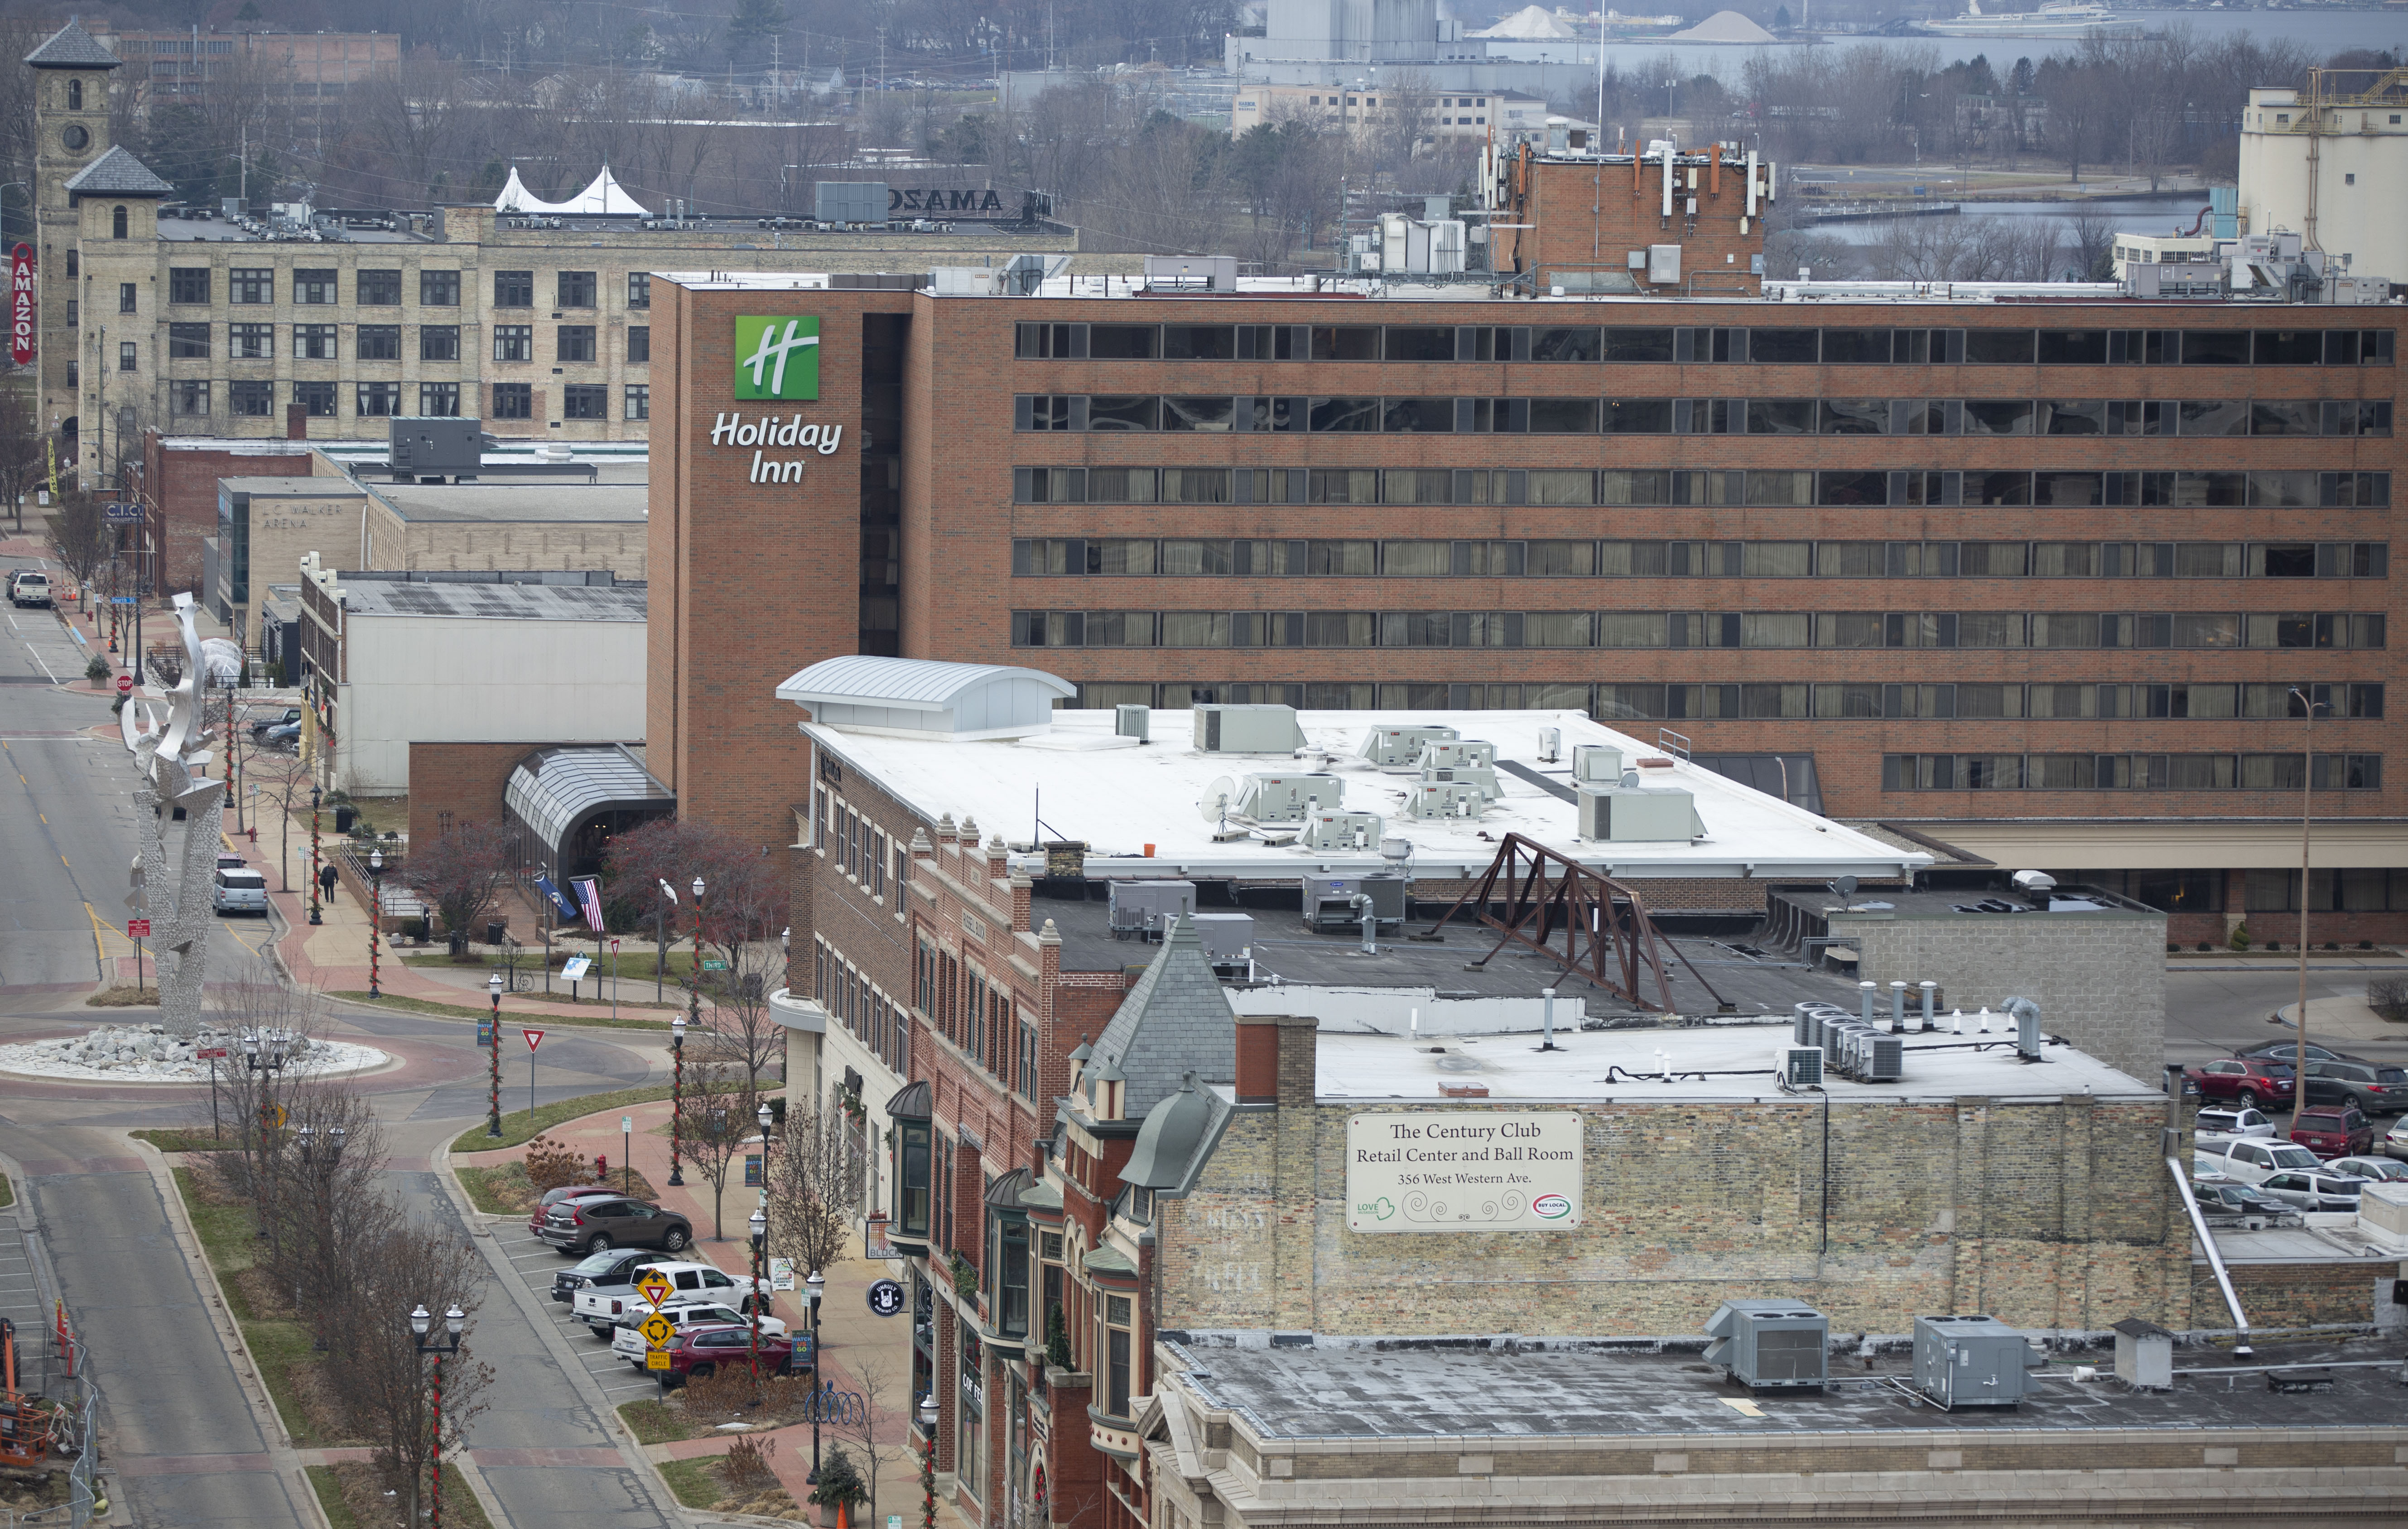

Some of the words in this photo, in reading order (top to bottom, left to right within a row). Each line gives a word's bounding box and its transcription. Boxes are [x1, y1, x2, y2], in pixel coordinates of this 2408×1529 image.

[15, 262, 31, 351] AMAZON
[710, 413, 842, 454] Holiday
[750, 450, 802, 483] Inn
[291, 504, 342, 515] WALKER
[264, 518, 308, 528] ARENA
[963, 912, 975, 934] RUSSELL
[976, 921, 985, 941] BLOCK
[1390, 1124, 1421, 1138] The
[1427, 1124, 1496, 1142] Century
[1501, 1122, 1541, 1138] Club
[1357, 1148, 1401, 1162] Retail
[1406, 1148, 1458, 1162] Center
[1462, 1147, 1489, 1161] and
[1494, 1147, 1523, 1161] Ball
[1527, 1147, 1574, 1160] Room
[1398, 1174, 1420, 1185] 356
[1423, 1173, 1452, 1184] West
[1455, 1173, 1503, 1184] Western
[1507, 1173, 1531, 1183] Ave.
[875, 1304, 891, 1313] BREWING
